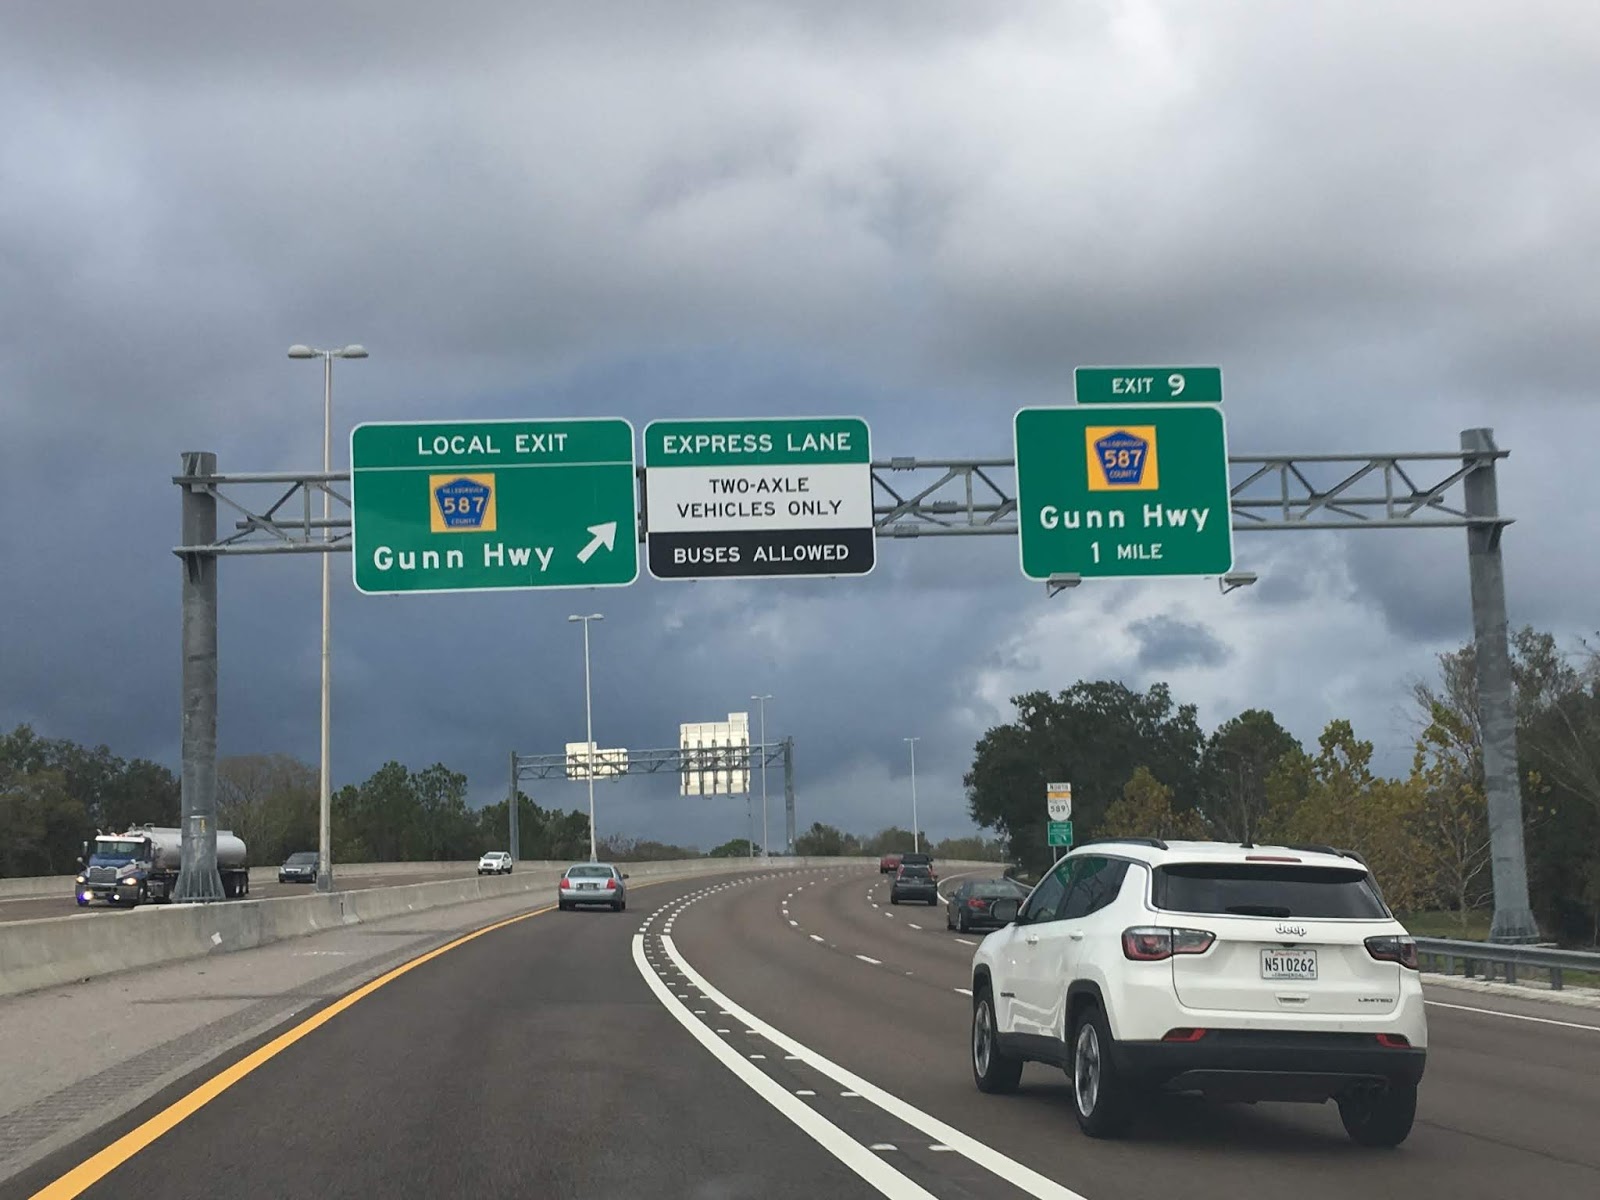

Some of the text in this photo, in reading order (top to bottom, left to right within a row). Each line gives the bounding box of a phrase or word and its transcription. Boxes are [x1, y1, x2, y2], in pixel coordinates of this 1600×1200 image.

[1112, 373, 1186, 396] EXIT 9
[418, 433, 568, 455] LOCAL EXIT
[663, 432, 851, 454] EXPRESS LANE
[1104, 449, 1143, 469] 587
[1109, 469, 1138, 479] COUNTY
[709, 477, 809, 494] TWO-AXLE
[444, 496, 485, 515] 587
[677, 500, 842, 518] VEHICLES ONLY
[1040, 503, 1210, 533] Gunn Hwy
[373, 543, 554, 572] Gunn Hwy
[674, 544, 849, 564] BUSES ALLOWED
[1091, 541, 1163, 564] 1 MILE
[1050, 804, 1066, 812] 589
[1275, 923, 1307, 936] Jeep
[1265, 957, 1315, 972] N510262
